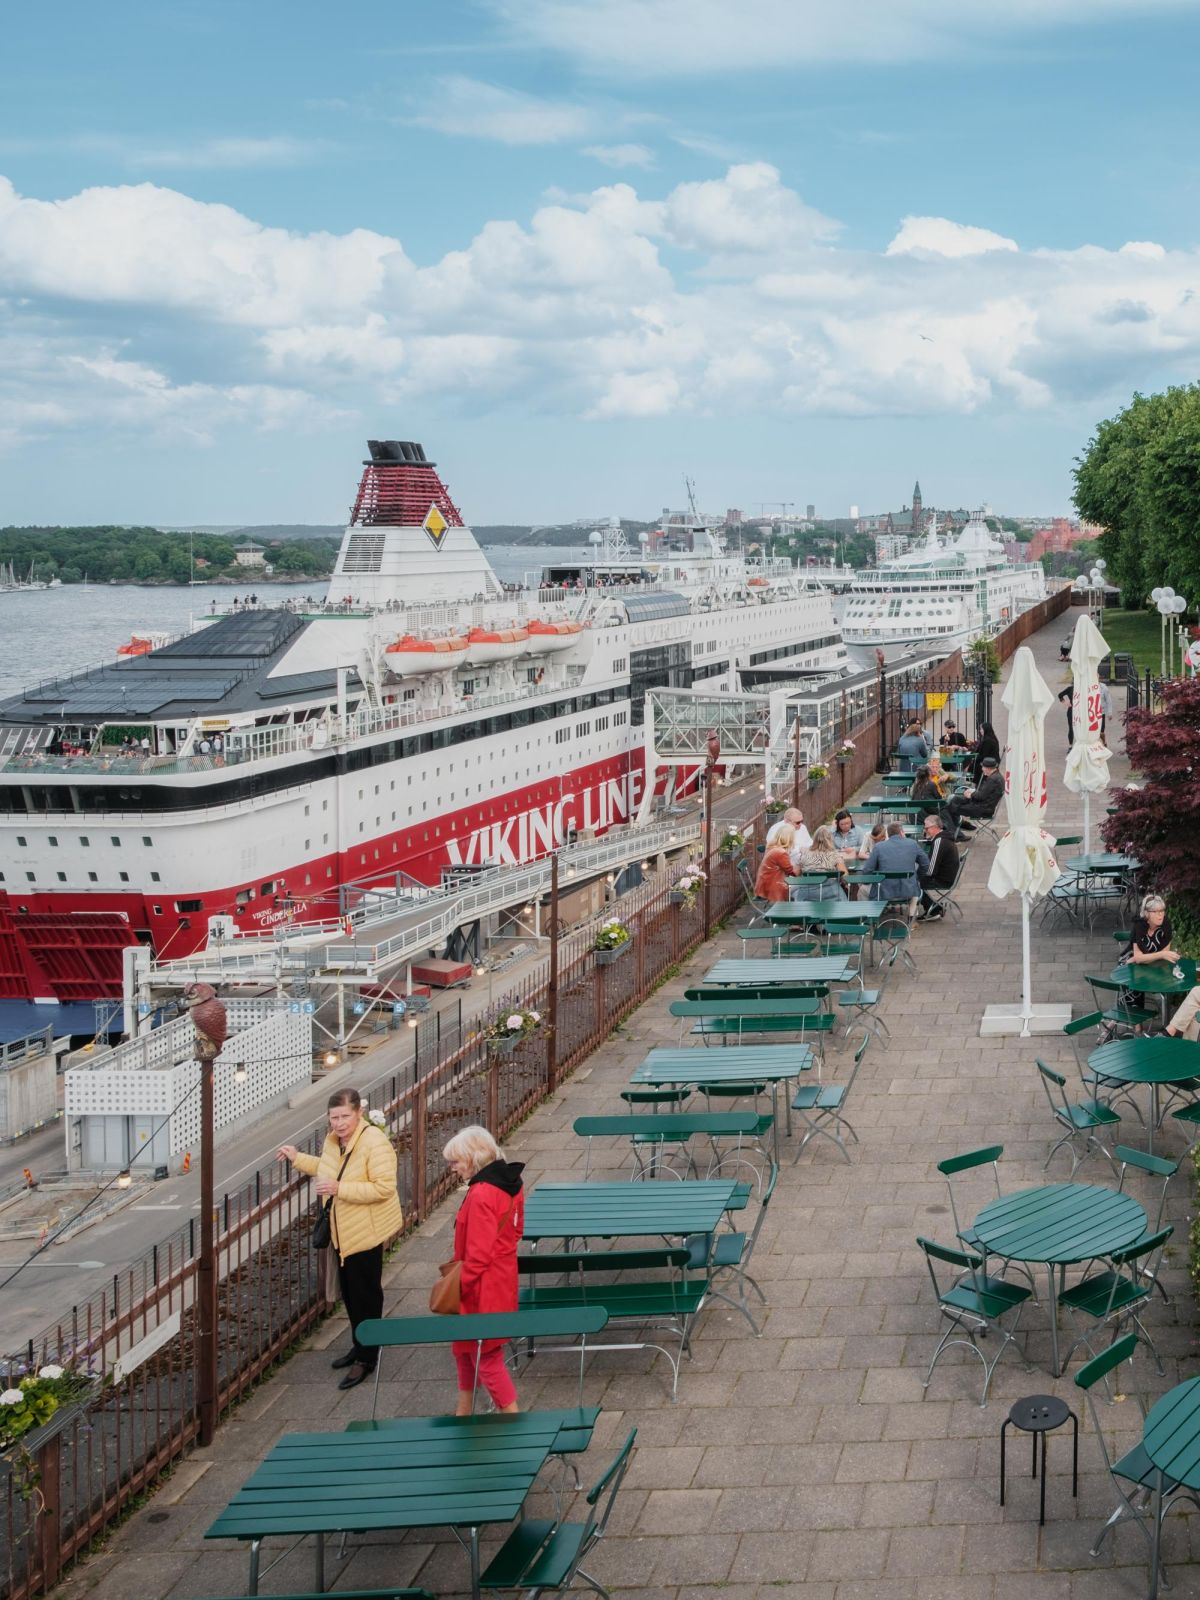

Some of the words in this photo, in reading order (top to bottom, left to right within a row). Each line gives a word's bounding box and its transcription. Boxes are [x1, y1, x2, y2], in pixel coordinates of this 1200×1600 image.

[445, 793, 577, 866] VIKING
[583, 767, 645, 834] LINE
[252, 908, 273, 920] VIKING
[260, 902, 307, 927] CINDERLLA
